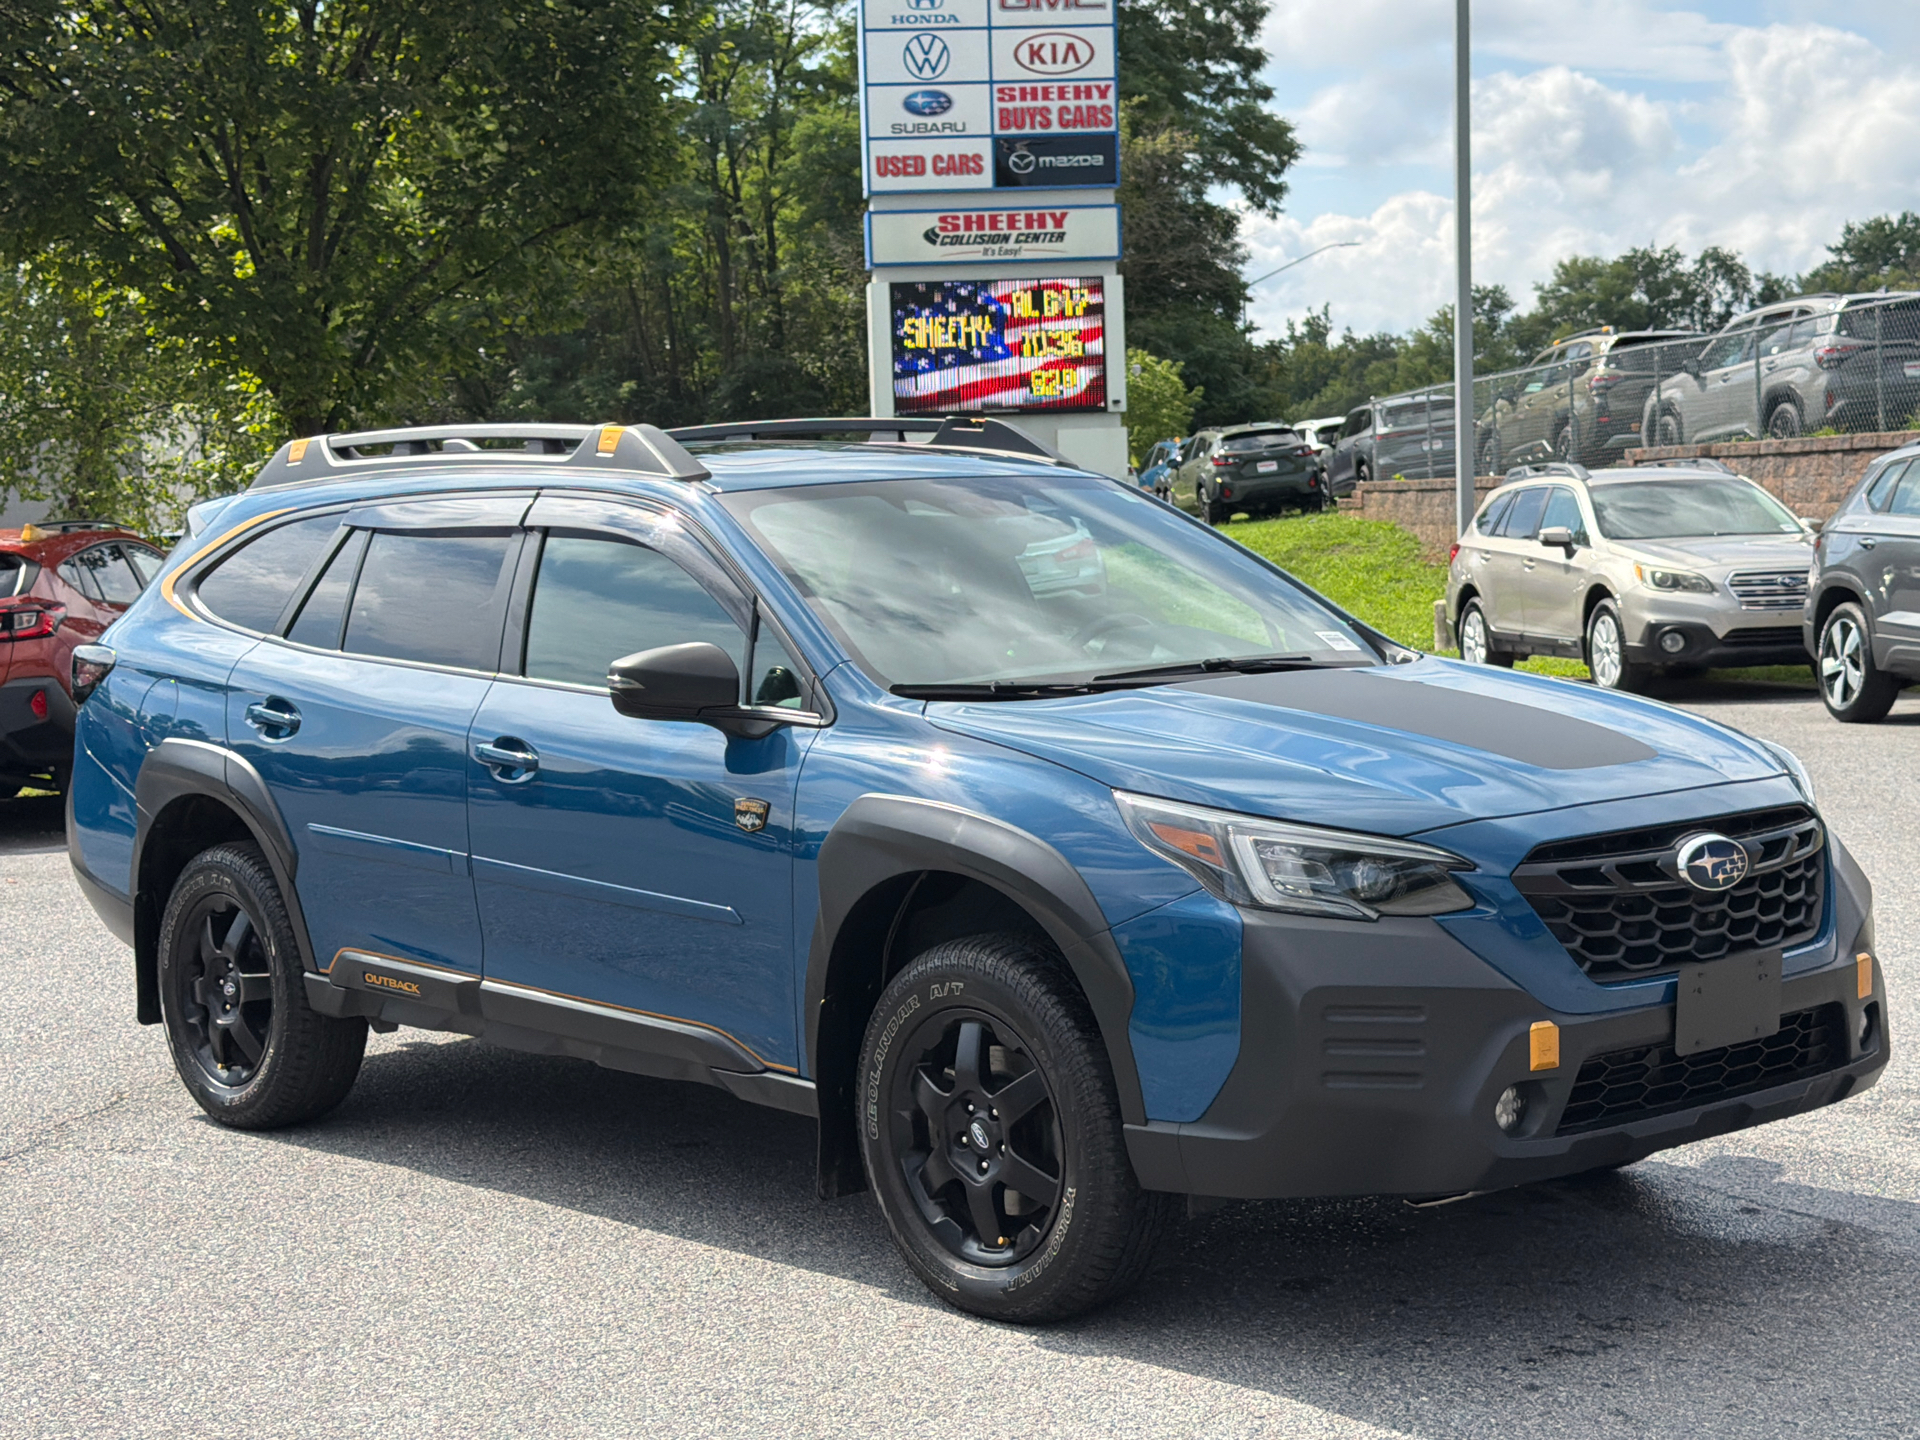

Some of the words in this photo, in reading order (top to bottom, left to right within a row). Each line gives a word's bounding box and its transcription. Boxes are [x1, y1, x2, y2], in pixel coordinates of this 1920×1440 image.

[891, 14, 960, 24] HONDA
[1028, 42, 1081, 65] KIA
[997, 84, 1112, 102] SHEEHY
[891, 122, 966, 134] SUBARU
[998, 106, 1052, 131] BUYS
[1057, 104, 1113, 129] CARS
[876, 155, 926, 178] USED
[932, 153, 984, 176] CARS
[938, 211, 1068, 232] SHEEHY
[940, 233, 1011, 246] COLLISION
[1014, 231, 1066, 244] CENTER
[903, 315, 992, 349] SHEEHY
[364, 973, 421, 995] OUTBACK
[867, 994, 921, 1140] GEOLANDAR
[930, 982, 964, 1000] A/T
[1006, 1187, 1077, 1292] YOKOHAMA
